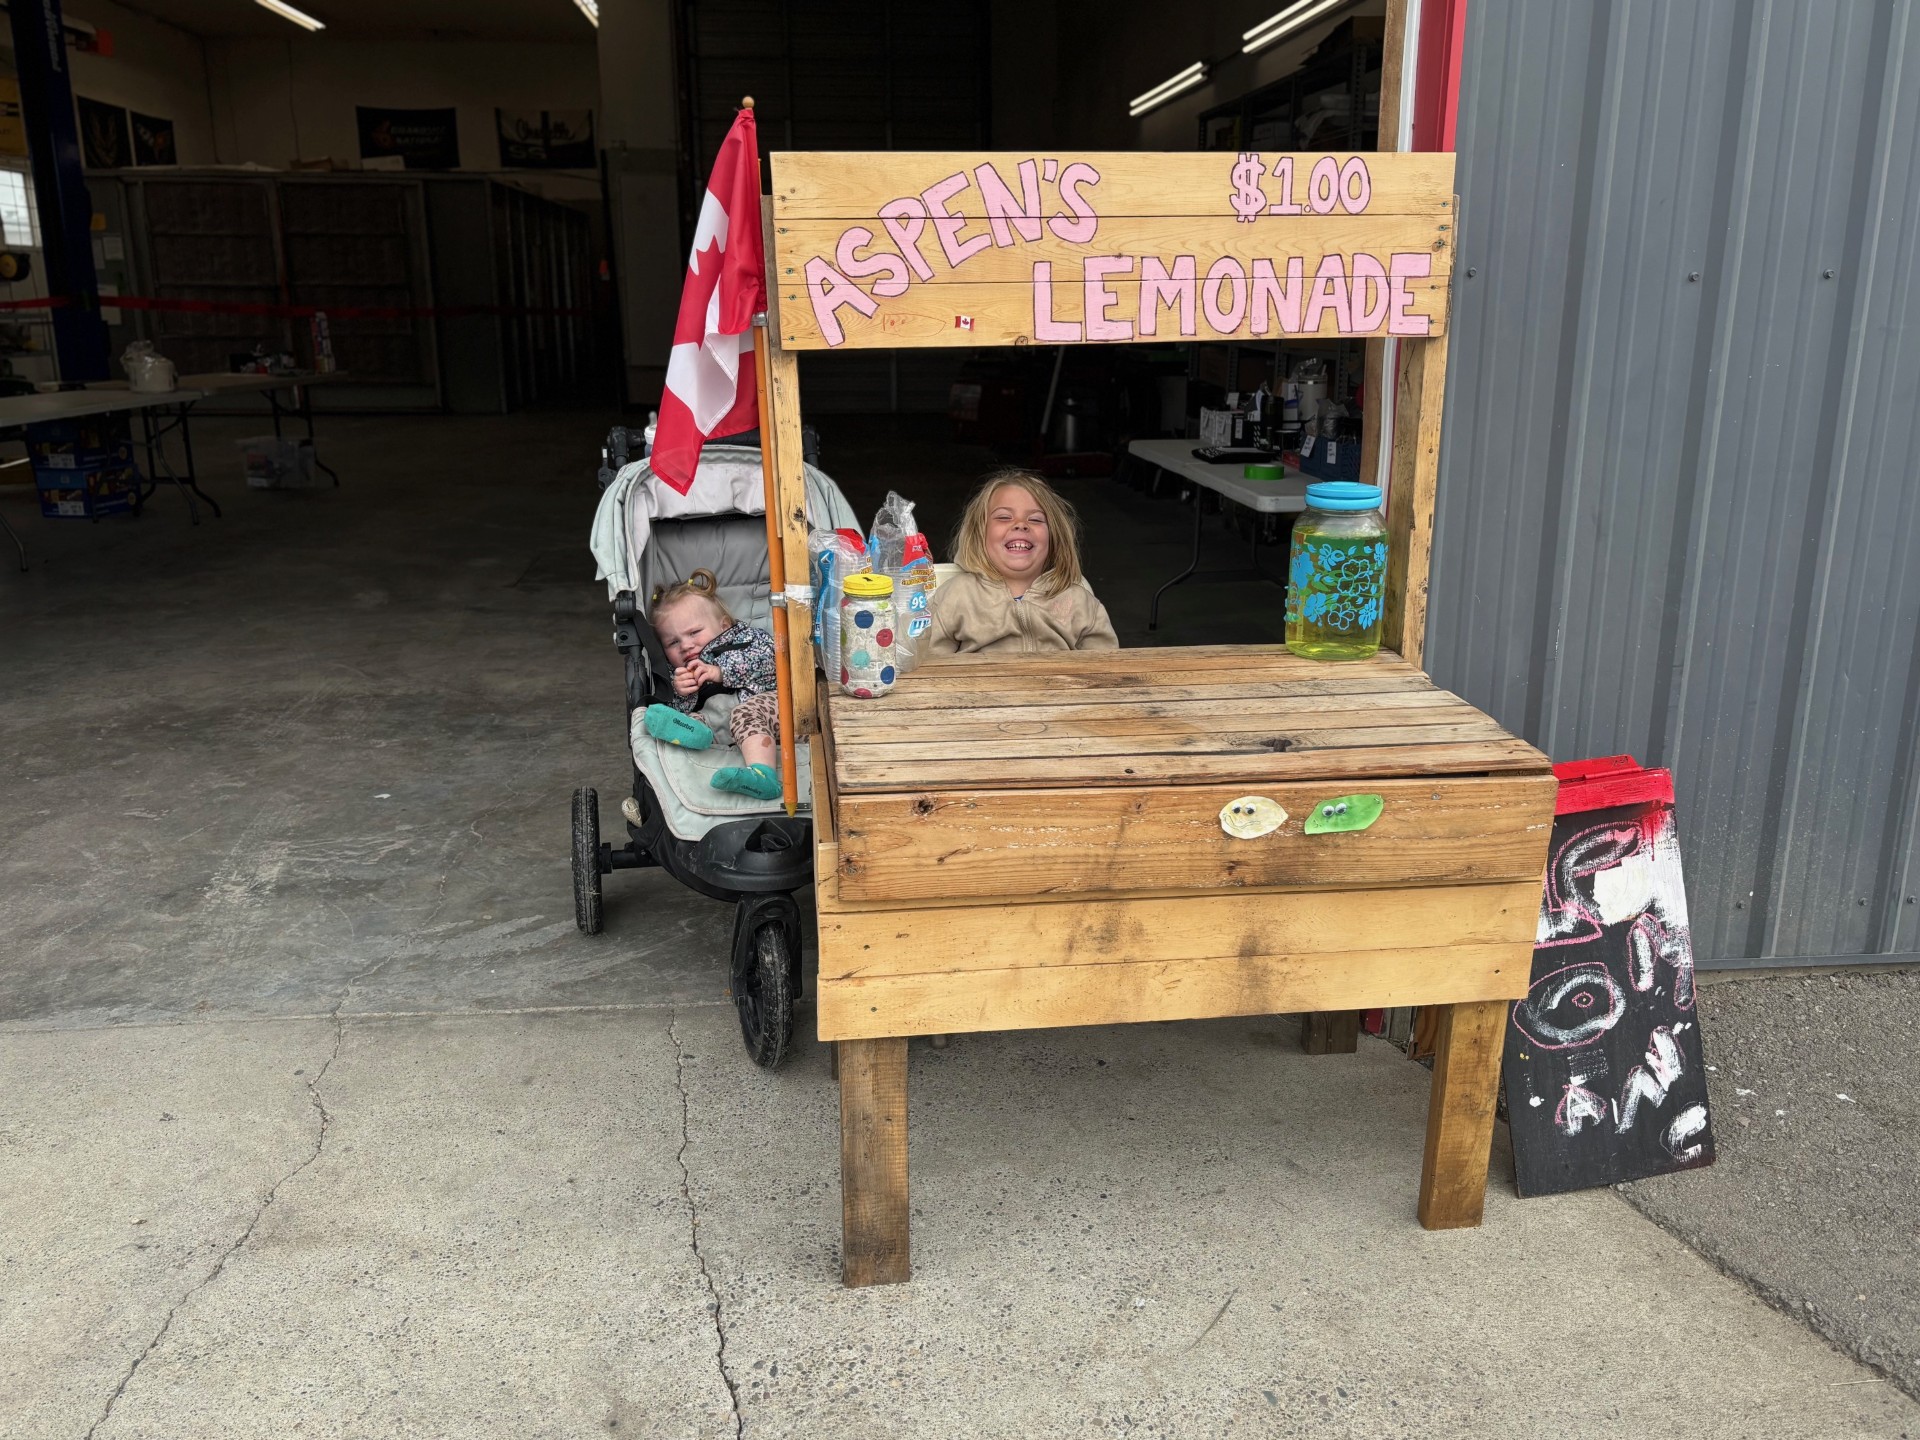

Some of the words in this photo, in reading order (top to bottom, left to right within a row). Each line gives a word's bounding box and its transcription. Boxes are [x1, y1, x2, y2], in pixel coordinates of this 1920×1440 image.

[1229, 152, 1372, 223] $1.00
[804, 158, 1101, 347] ASPEN'S
[1032, 252, 1432, 342] LEMONADE
